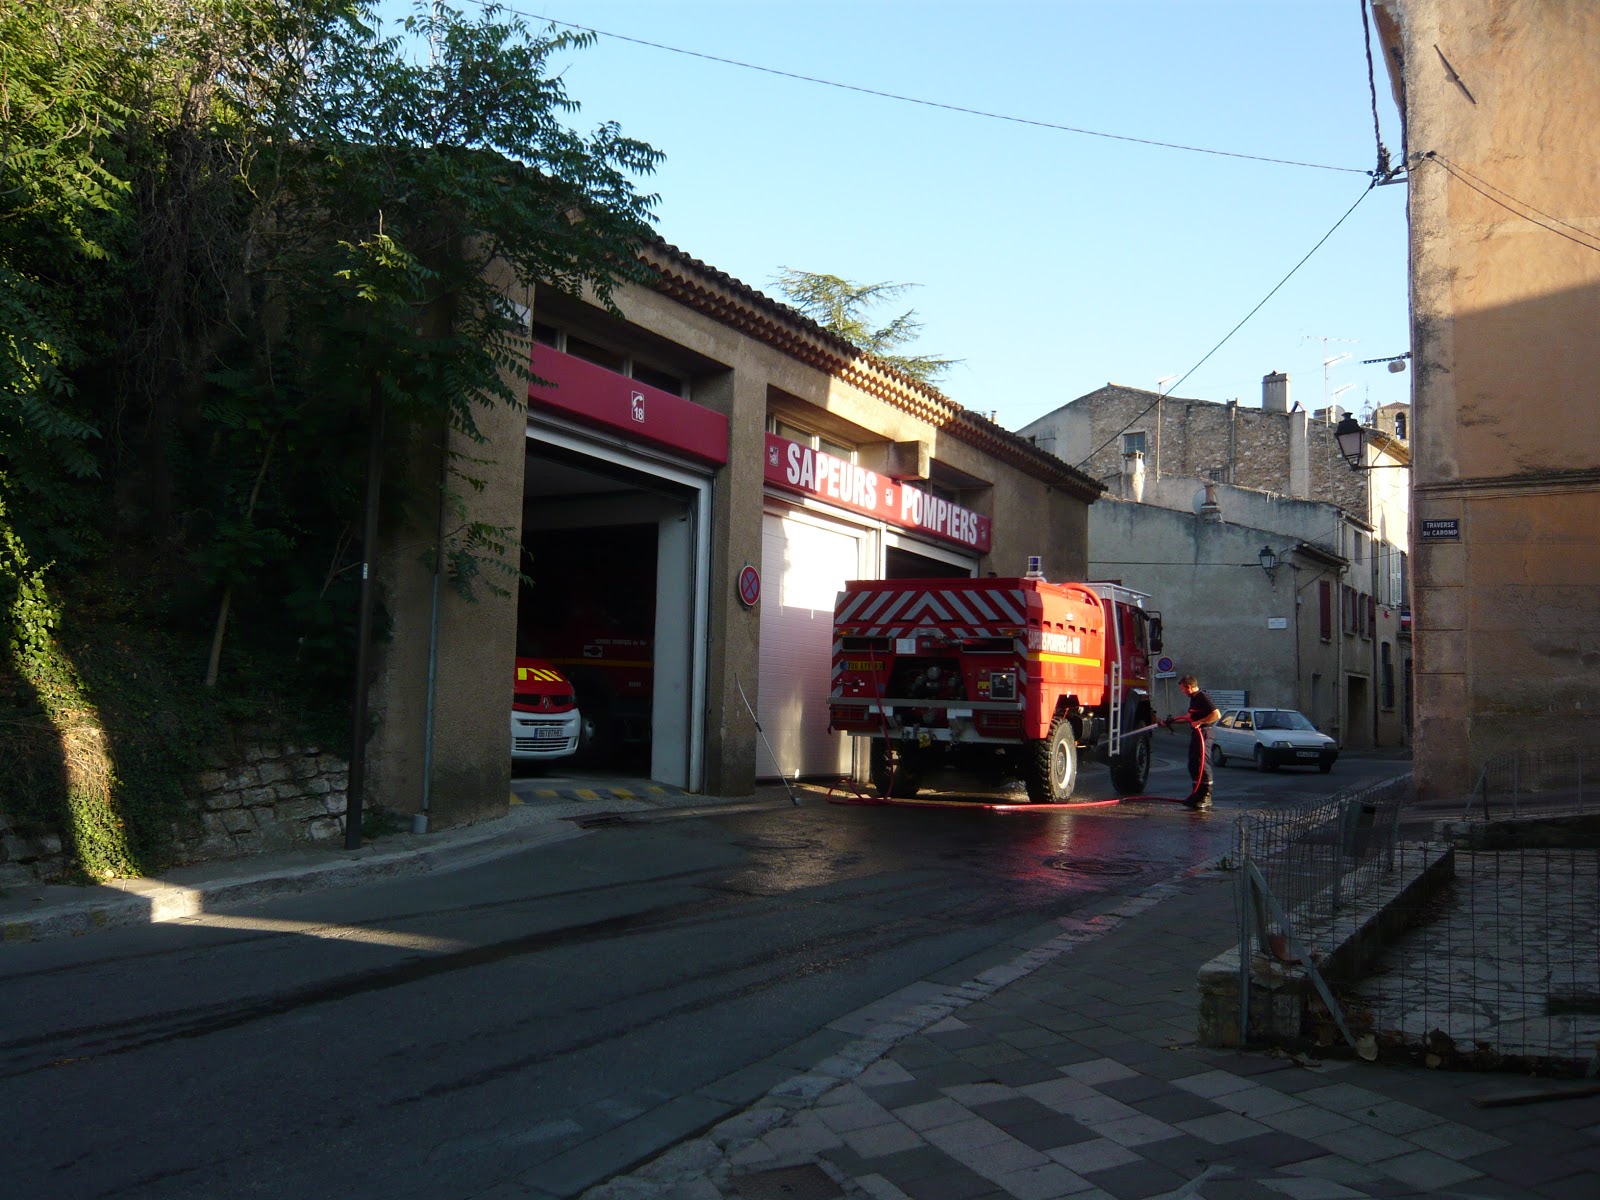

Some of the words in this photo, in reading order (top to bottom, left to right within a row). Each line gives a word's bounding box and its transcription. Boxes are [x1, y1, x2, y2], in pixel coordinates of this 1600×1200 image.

[633, 406, 644, 421] 18
[786, 442, 877, 511] SAPEURS
[900, 482, 978, 545] POMPIERS
[1426, 521, 1455, 529] TRAVERSE
